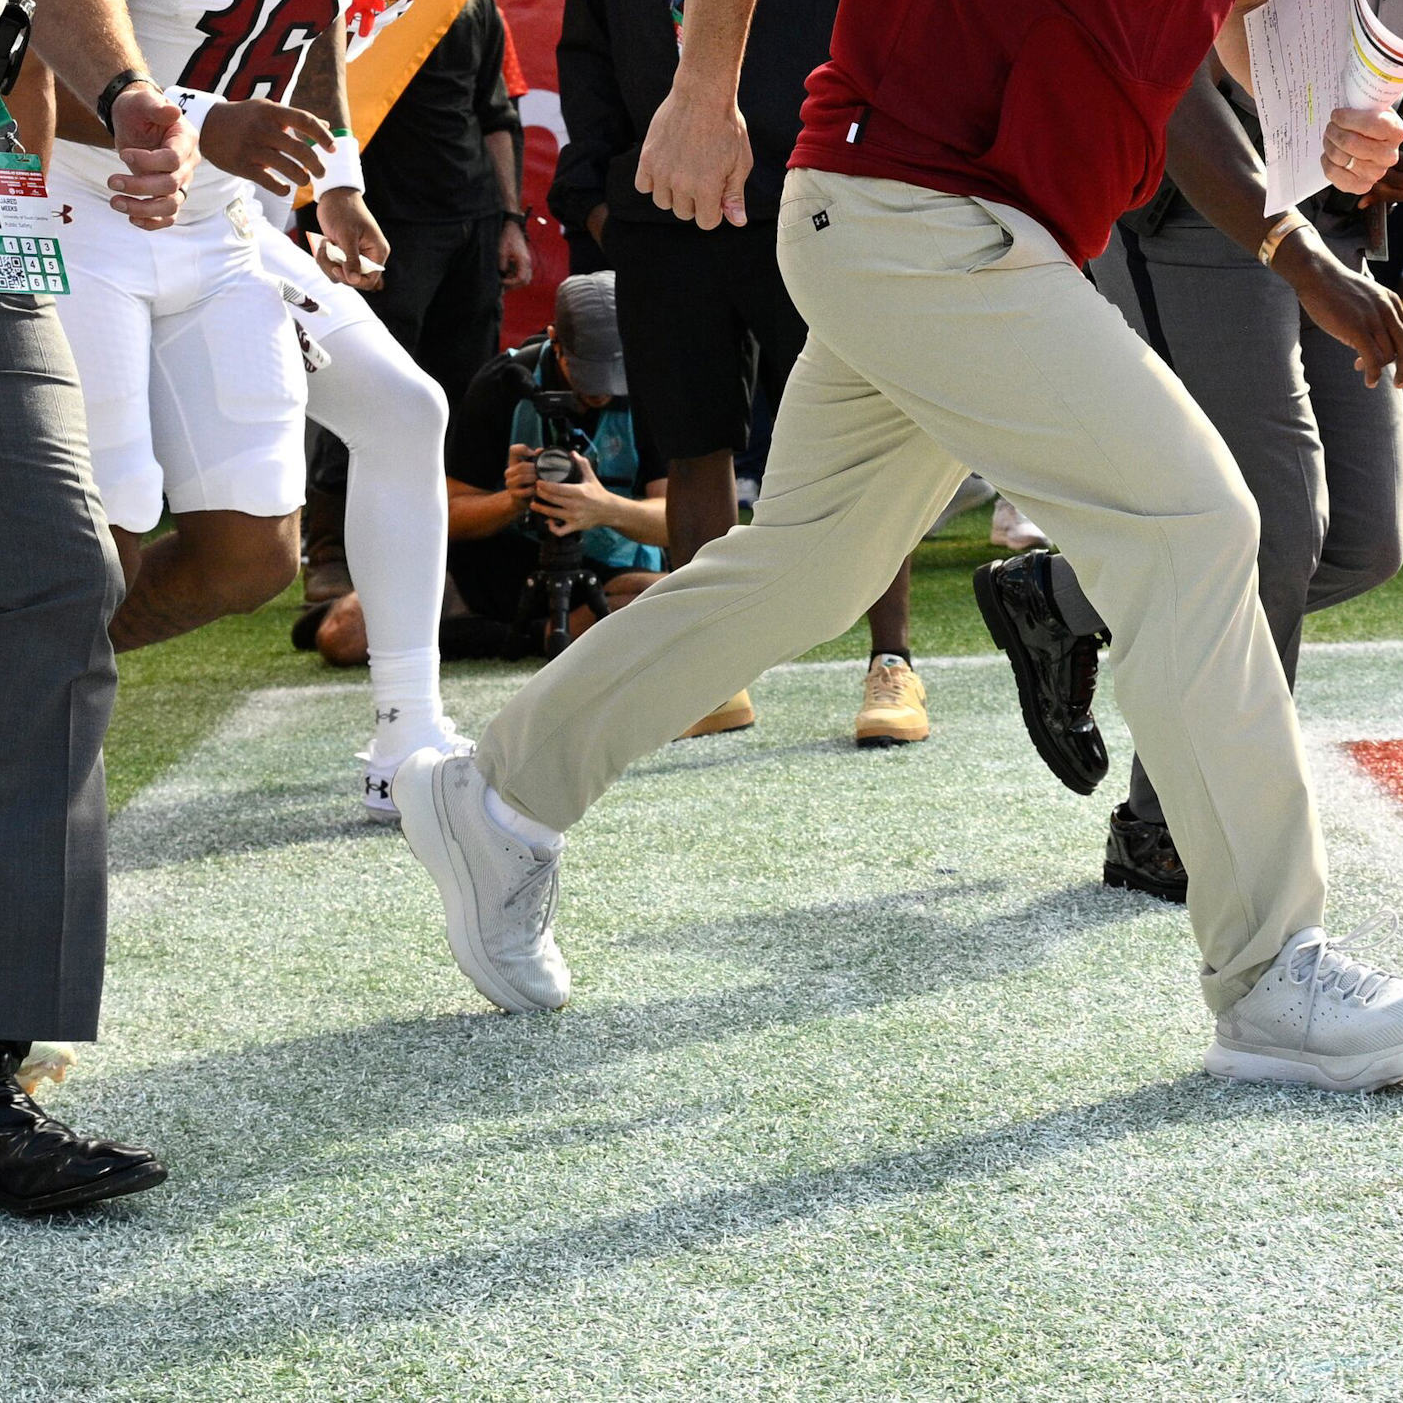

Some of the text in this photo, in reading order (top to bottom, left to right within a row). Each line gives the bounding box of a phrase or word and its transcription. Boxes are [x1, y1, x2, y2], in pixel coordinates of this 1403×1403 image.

[26, 241, 32, 251] 2
[44, 242, 50, 252] 3
[30, 260, 36, 269] 4
[34, 278, 40, 287] 6
